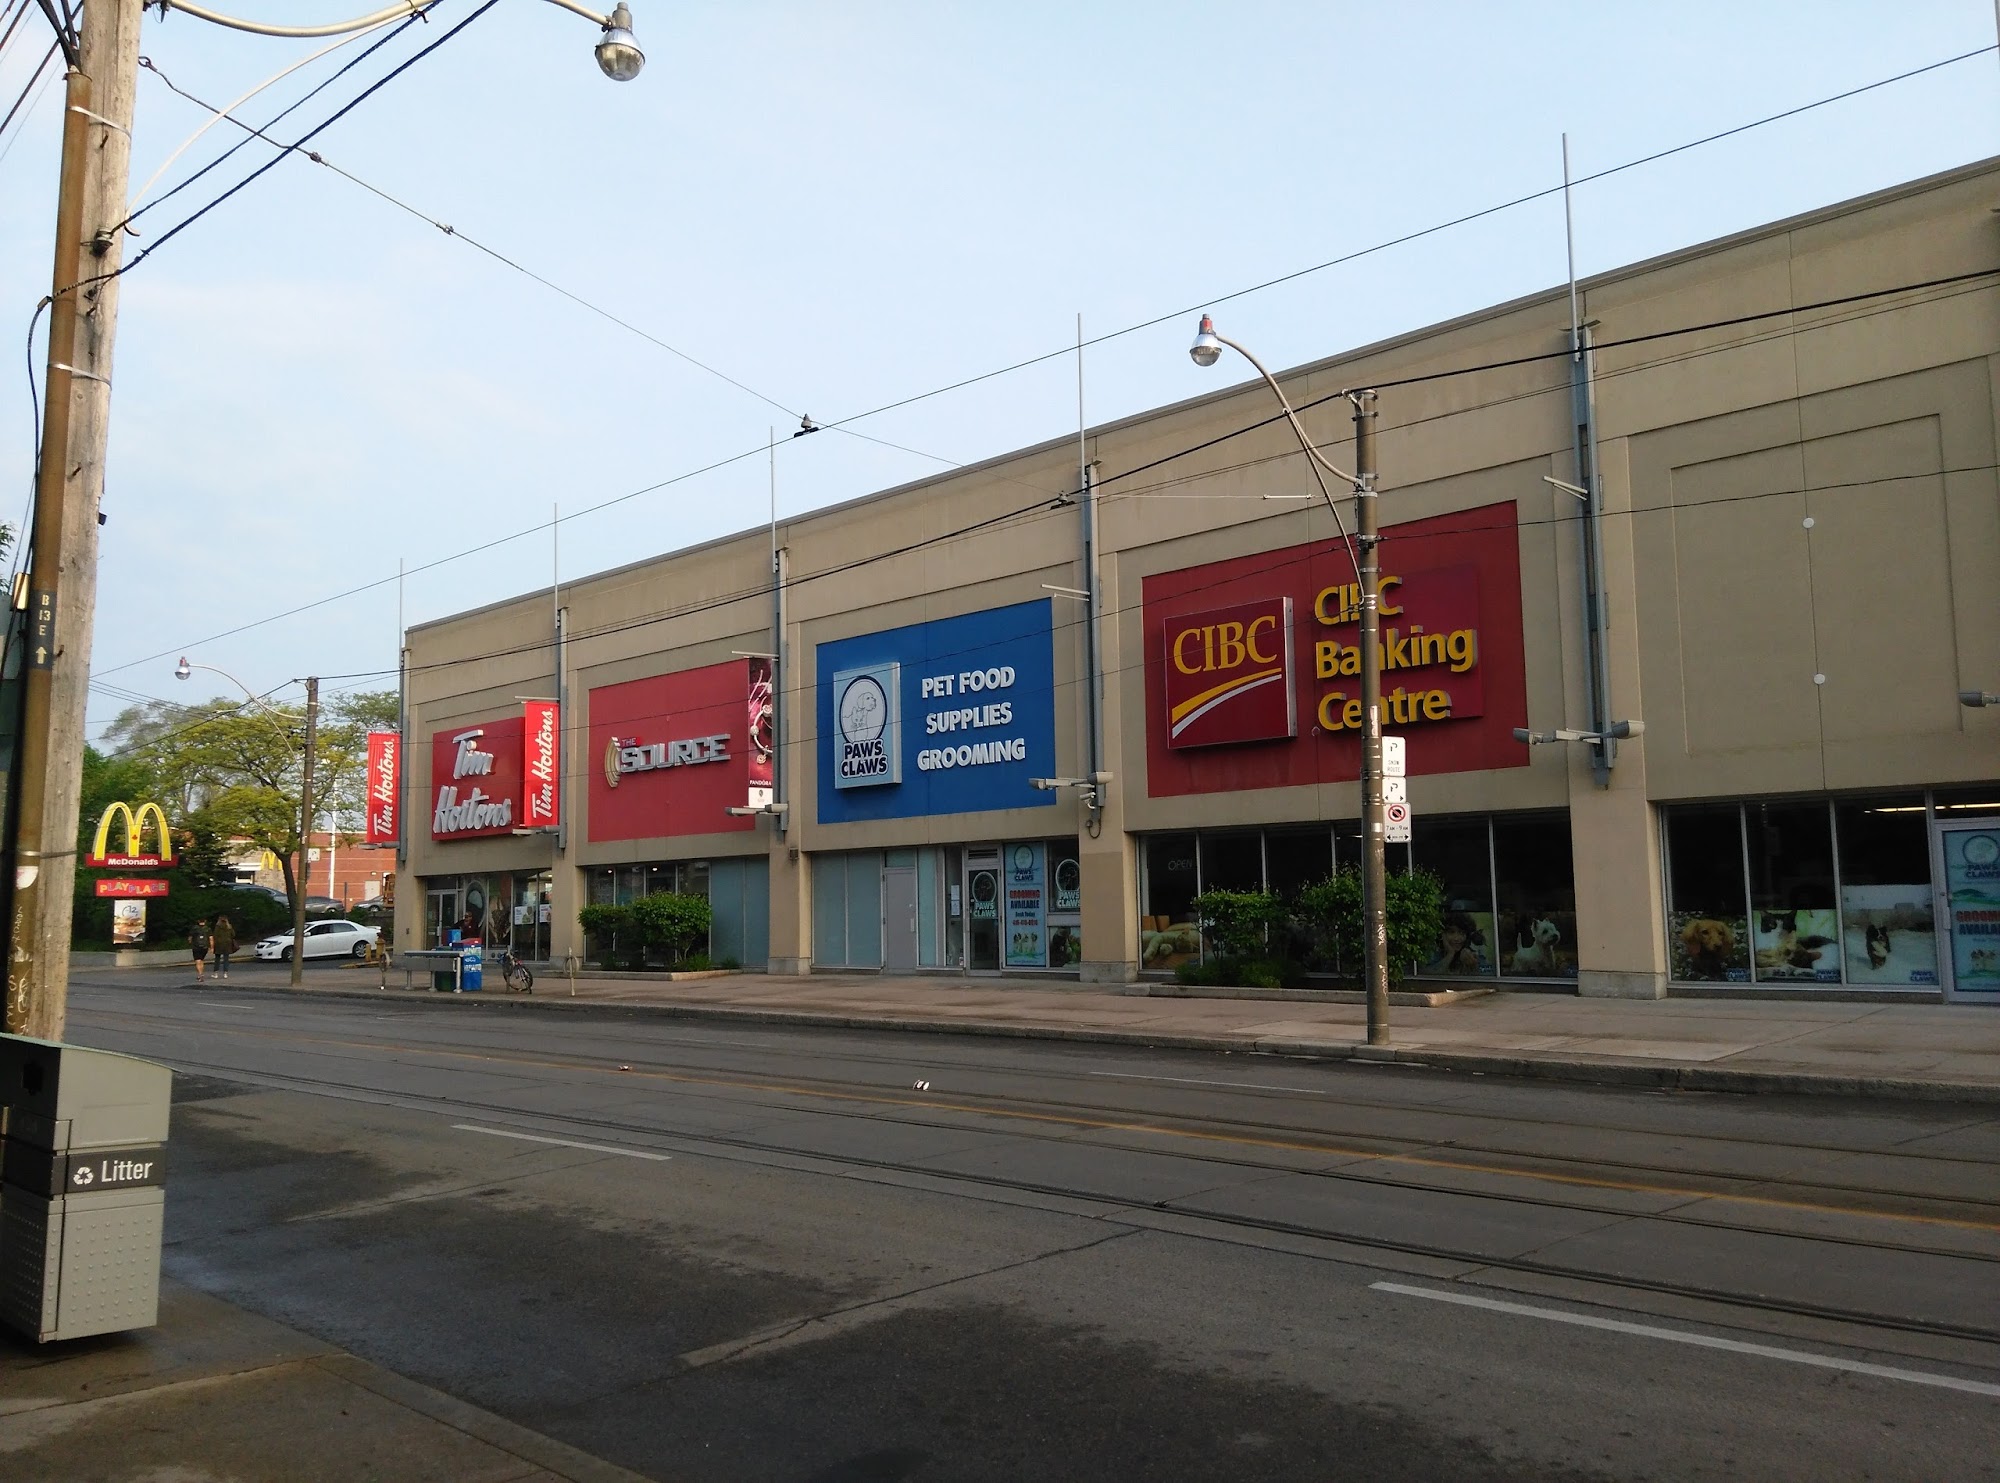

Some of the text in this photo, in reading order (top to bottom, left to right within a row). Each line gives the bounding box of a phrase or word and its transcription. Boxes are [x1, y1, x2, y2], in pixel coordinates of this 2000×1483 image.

[41, 594, 50, 606] B
[39, 609, 51, 621] 13
[39, 624, 47, 636] E
[1173, 615, 1278, 675] CIBC
[922, 666, 1015, 698] PET FOOD
[926, 702, 1012, 734] SUPPLIES
[621, 737, 637, 747] THE
[844, 740, 884, 760] PAWS
[452, 729, 494, 780] Tim
[531, 710, 554, 818] Tim Hortons
[620, 734, 731, 773] SOURCE
[917, 738, 1026, 771] GROOMING
[841, 756, 888, 777] CLAWS
[373, 740, 395, 836] Tim Hortons
[433, 785, 512, 833] Hortons
[107, 858, 159, 866] McDonald's
[1168, 859, 1193, 871] OPEN
[100, 881, 166, 894] PLAYPLACE
[1059, 891, 1080, 899] PAWS
[973, 909, 996, 917] CLAWS
[101, 1160, 154, 1183] Litter
